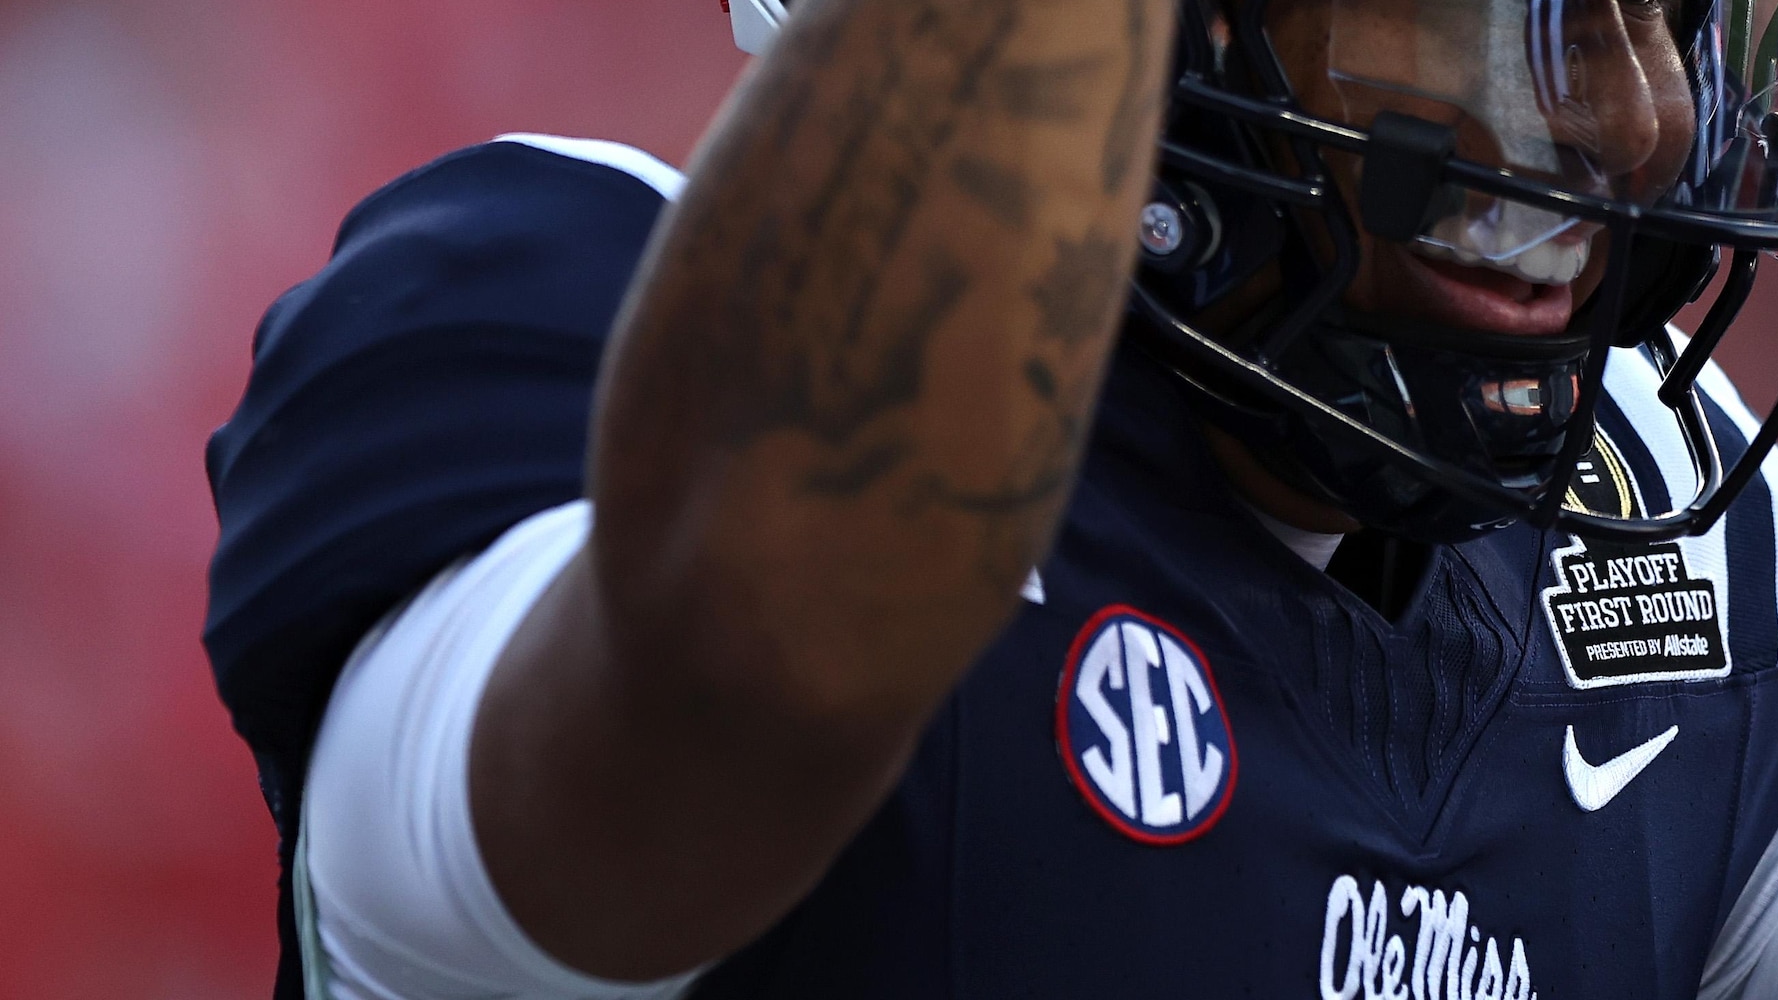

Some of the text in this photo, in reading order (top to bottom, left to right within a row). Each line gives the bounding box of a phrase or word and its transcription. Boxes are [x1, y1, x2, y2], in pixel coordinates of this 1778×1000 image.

[1569, 552, 1680, 594] PLAYOFF
[1557, 589, 1714, 634] FIRST ROUND
[1585, 633, 1709, 662] PRESENTED BY Allstate
[1075, 621, 1225, 827] SEC
[1319, 874, 1538, 1000] Ole Miss
